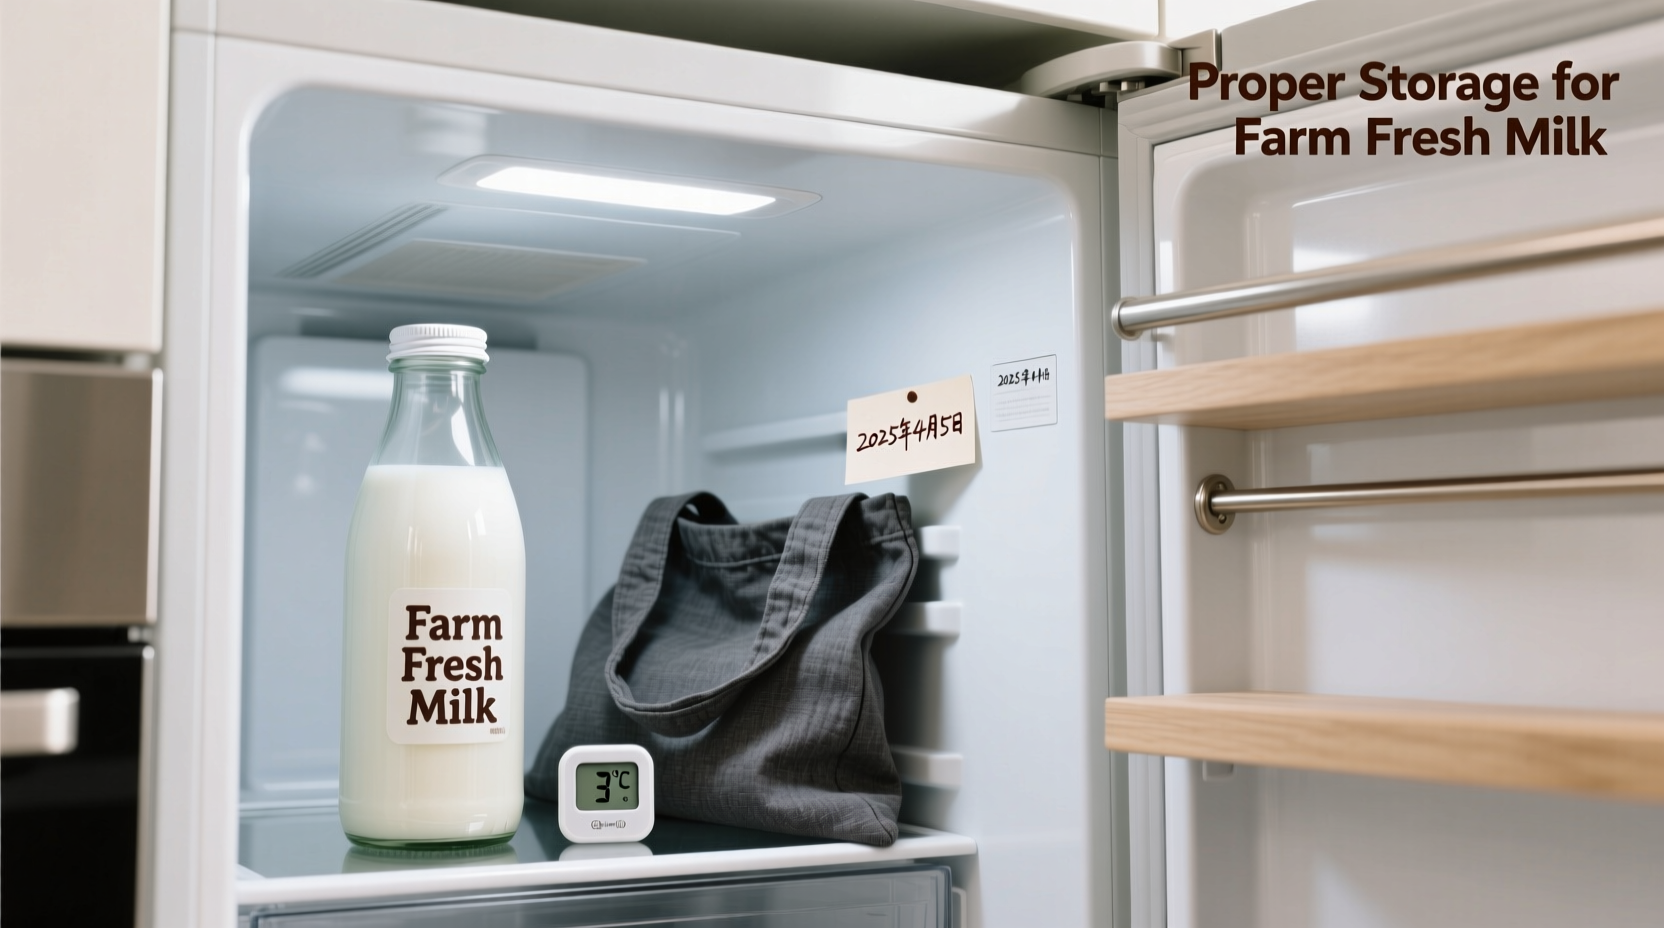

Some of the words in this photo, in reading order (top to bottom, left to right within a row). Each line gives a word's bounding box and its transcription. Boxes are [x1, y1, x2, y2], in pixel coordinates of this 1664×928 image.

[856, 411, 964, 453] 2025年4月5日
[405, 604, 503, 641] Farm
[401, 645, 504, 682] Fresh
[406, 686, 498, 726] Milk
